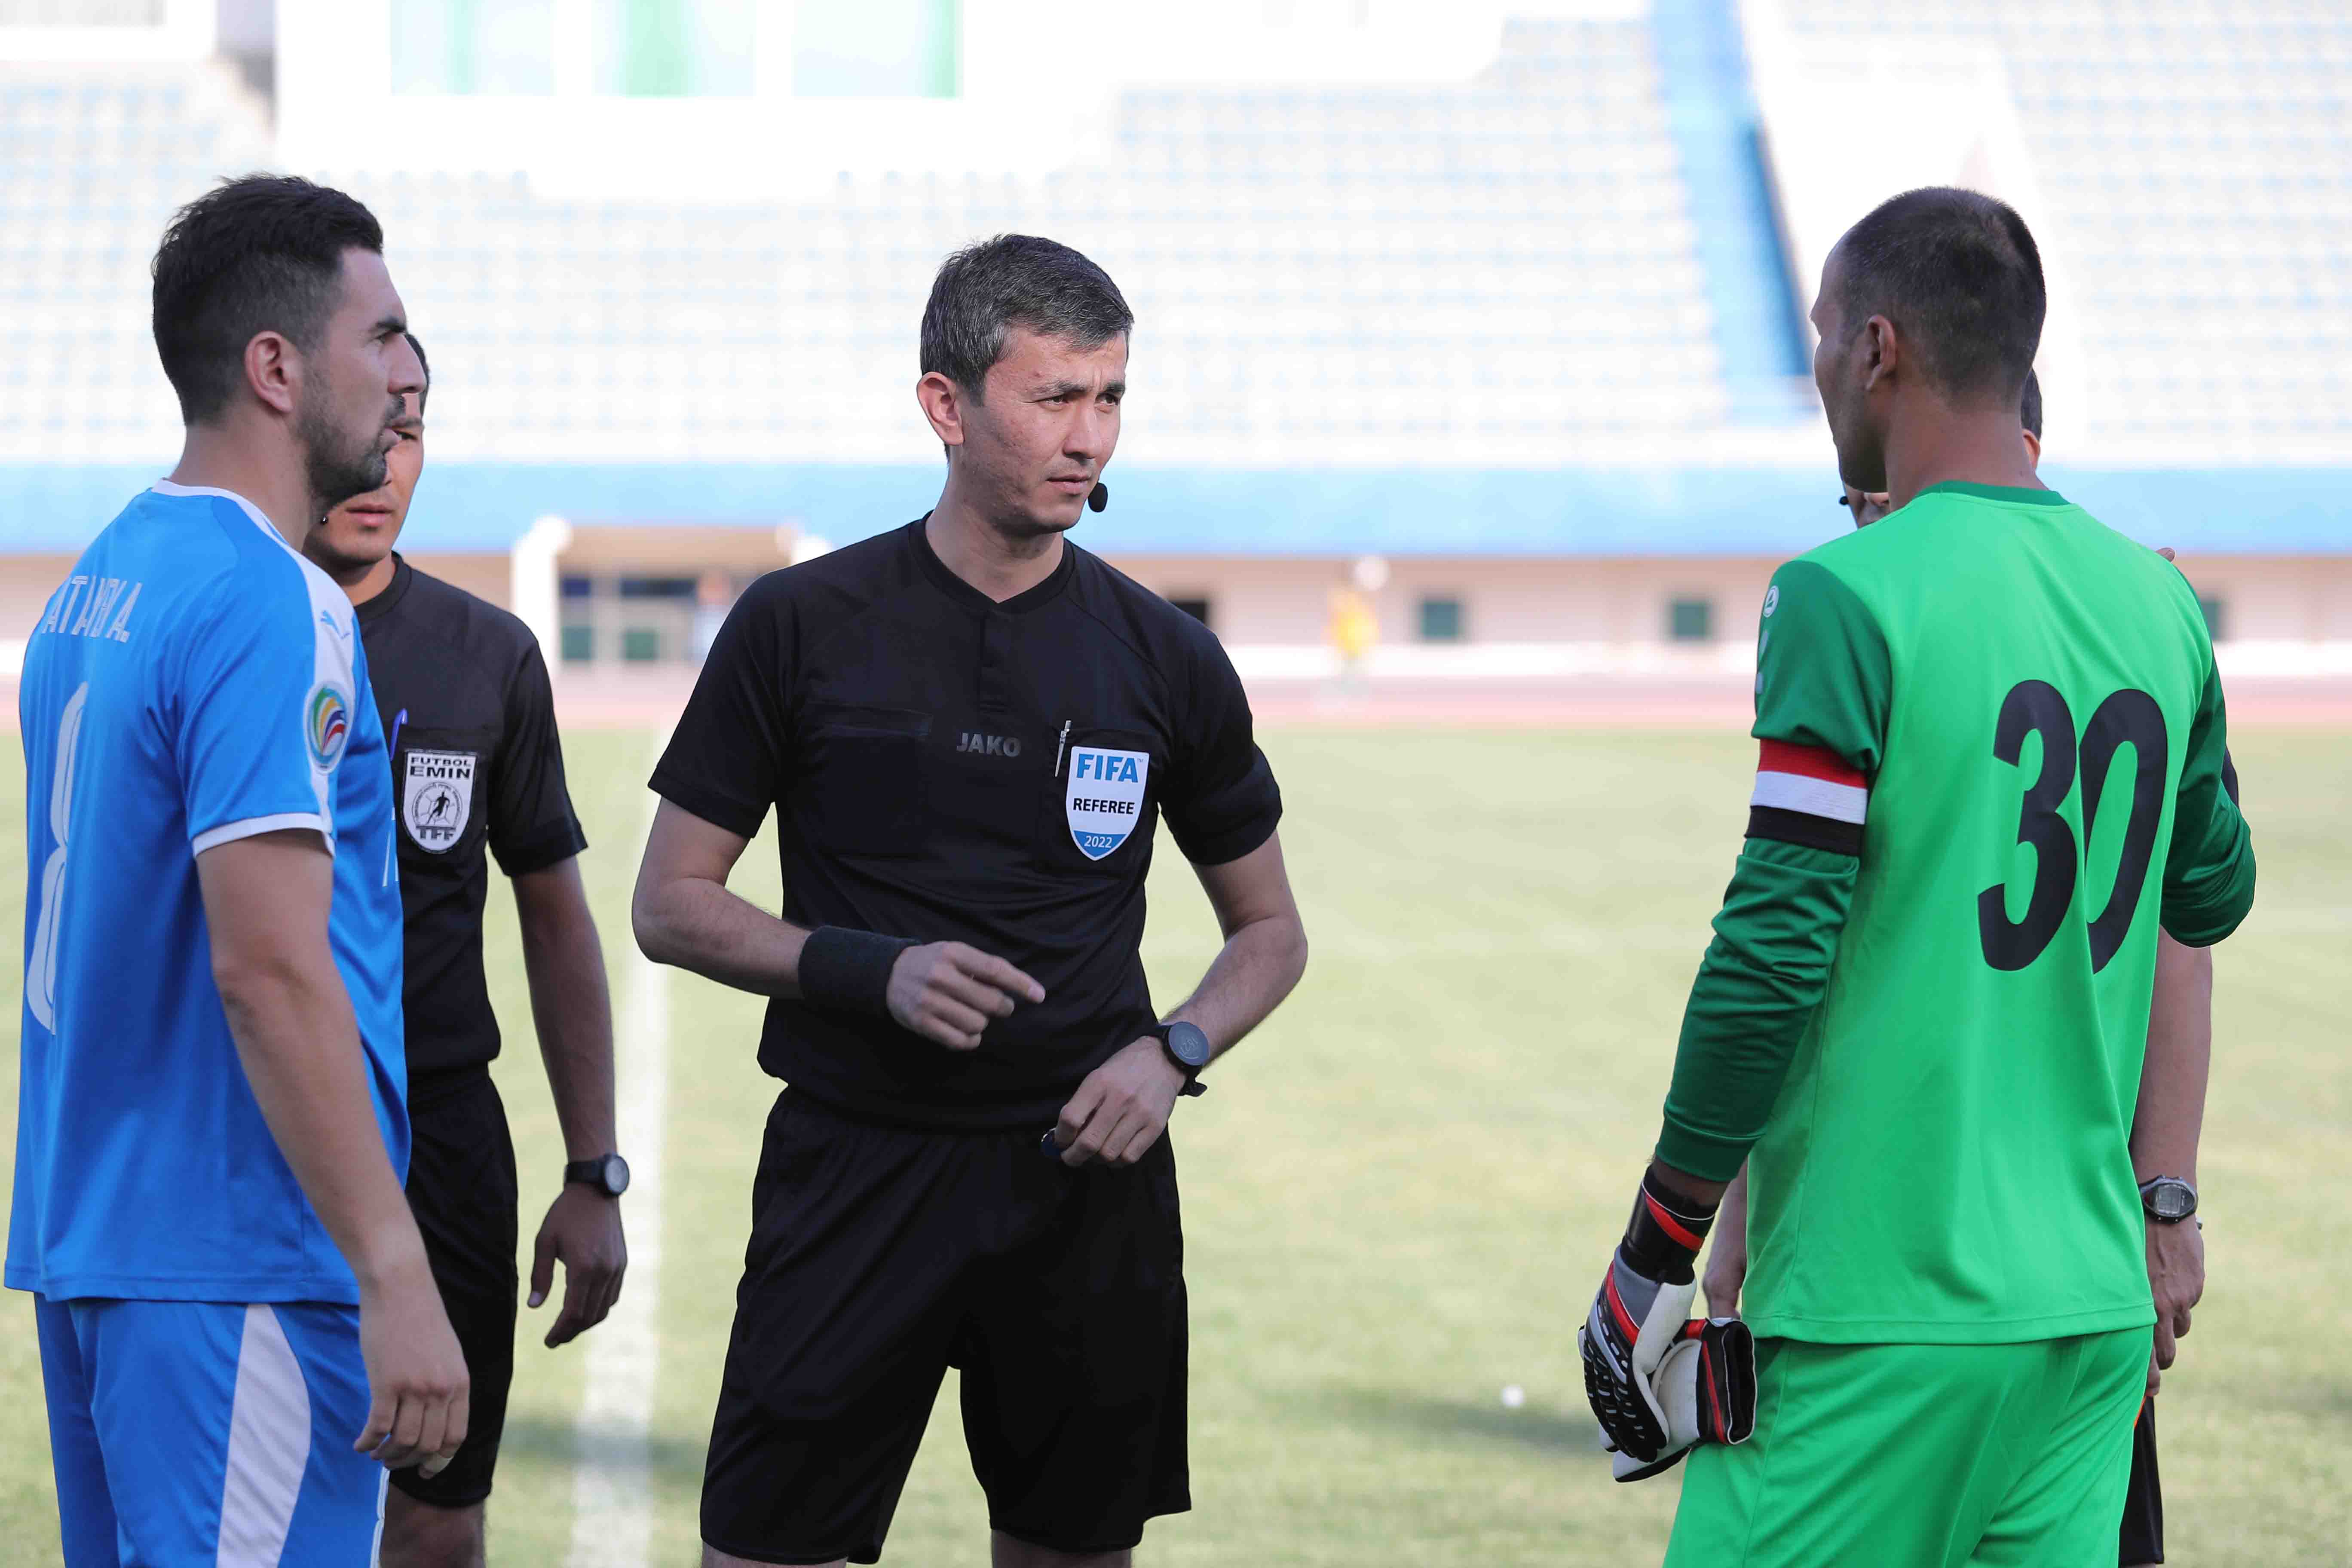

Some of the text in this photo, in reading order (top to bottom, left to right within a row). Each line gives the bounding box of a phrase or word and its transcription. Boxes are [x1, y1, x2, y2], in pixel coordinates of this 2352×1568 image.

[956, 732, 1022, 757] JAKO
[411, 757, 471, 766] FUTBOL
[1077, 753, 1138, 783] FIFA
[410, 766, 470, 778] EMIN
[1073, 798, 1135, 815] REFEREE
[1977, 679, 2168, 974] 30
[1084, 836, 1112, 848] 2022
